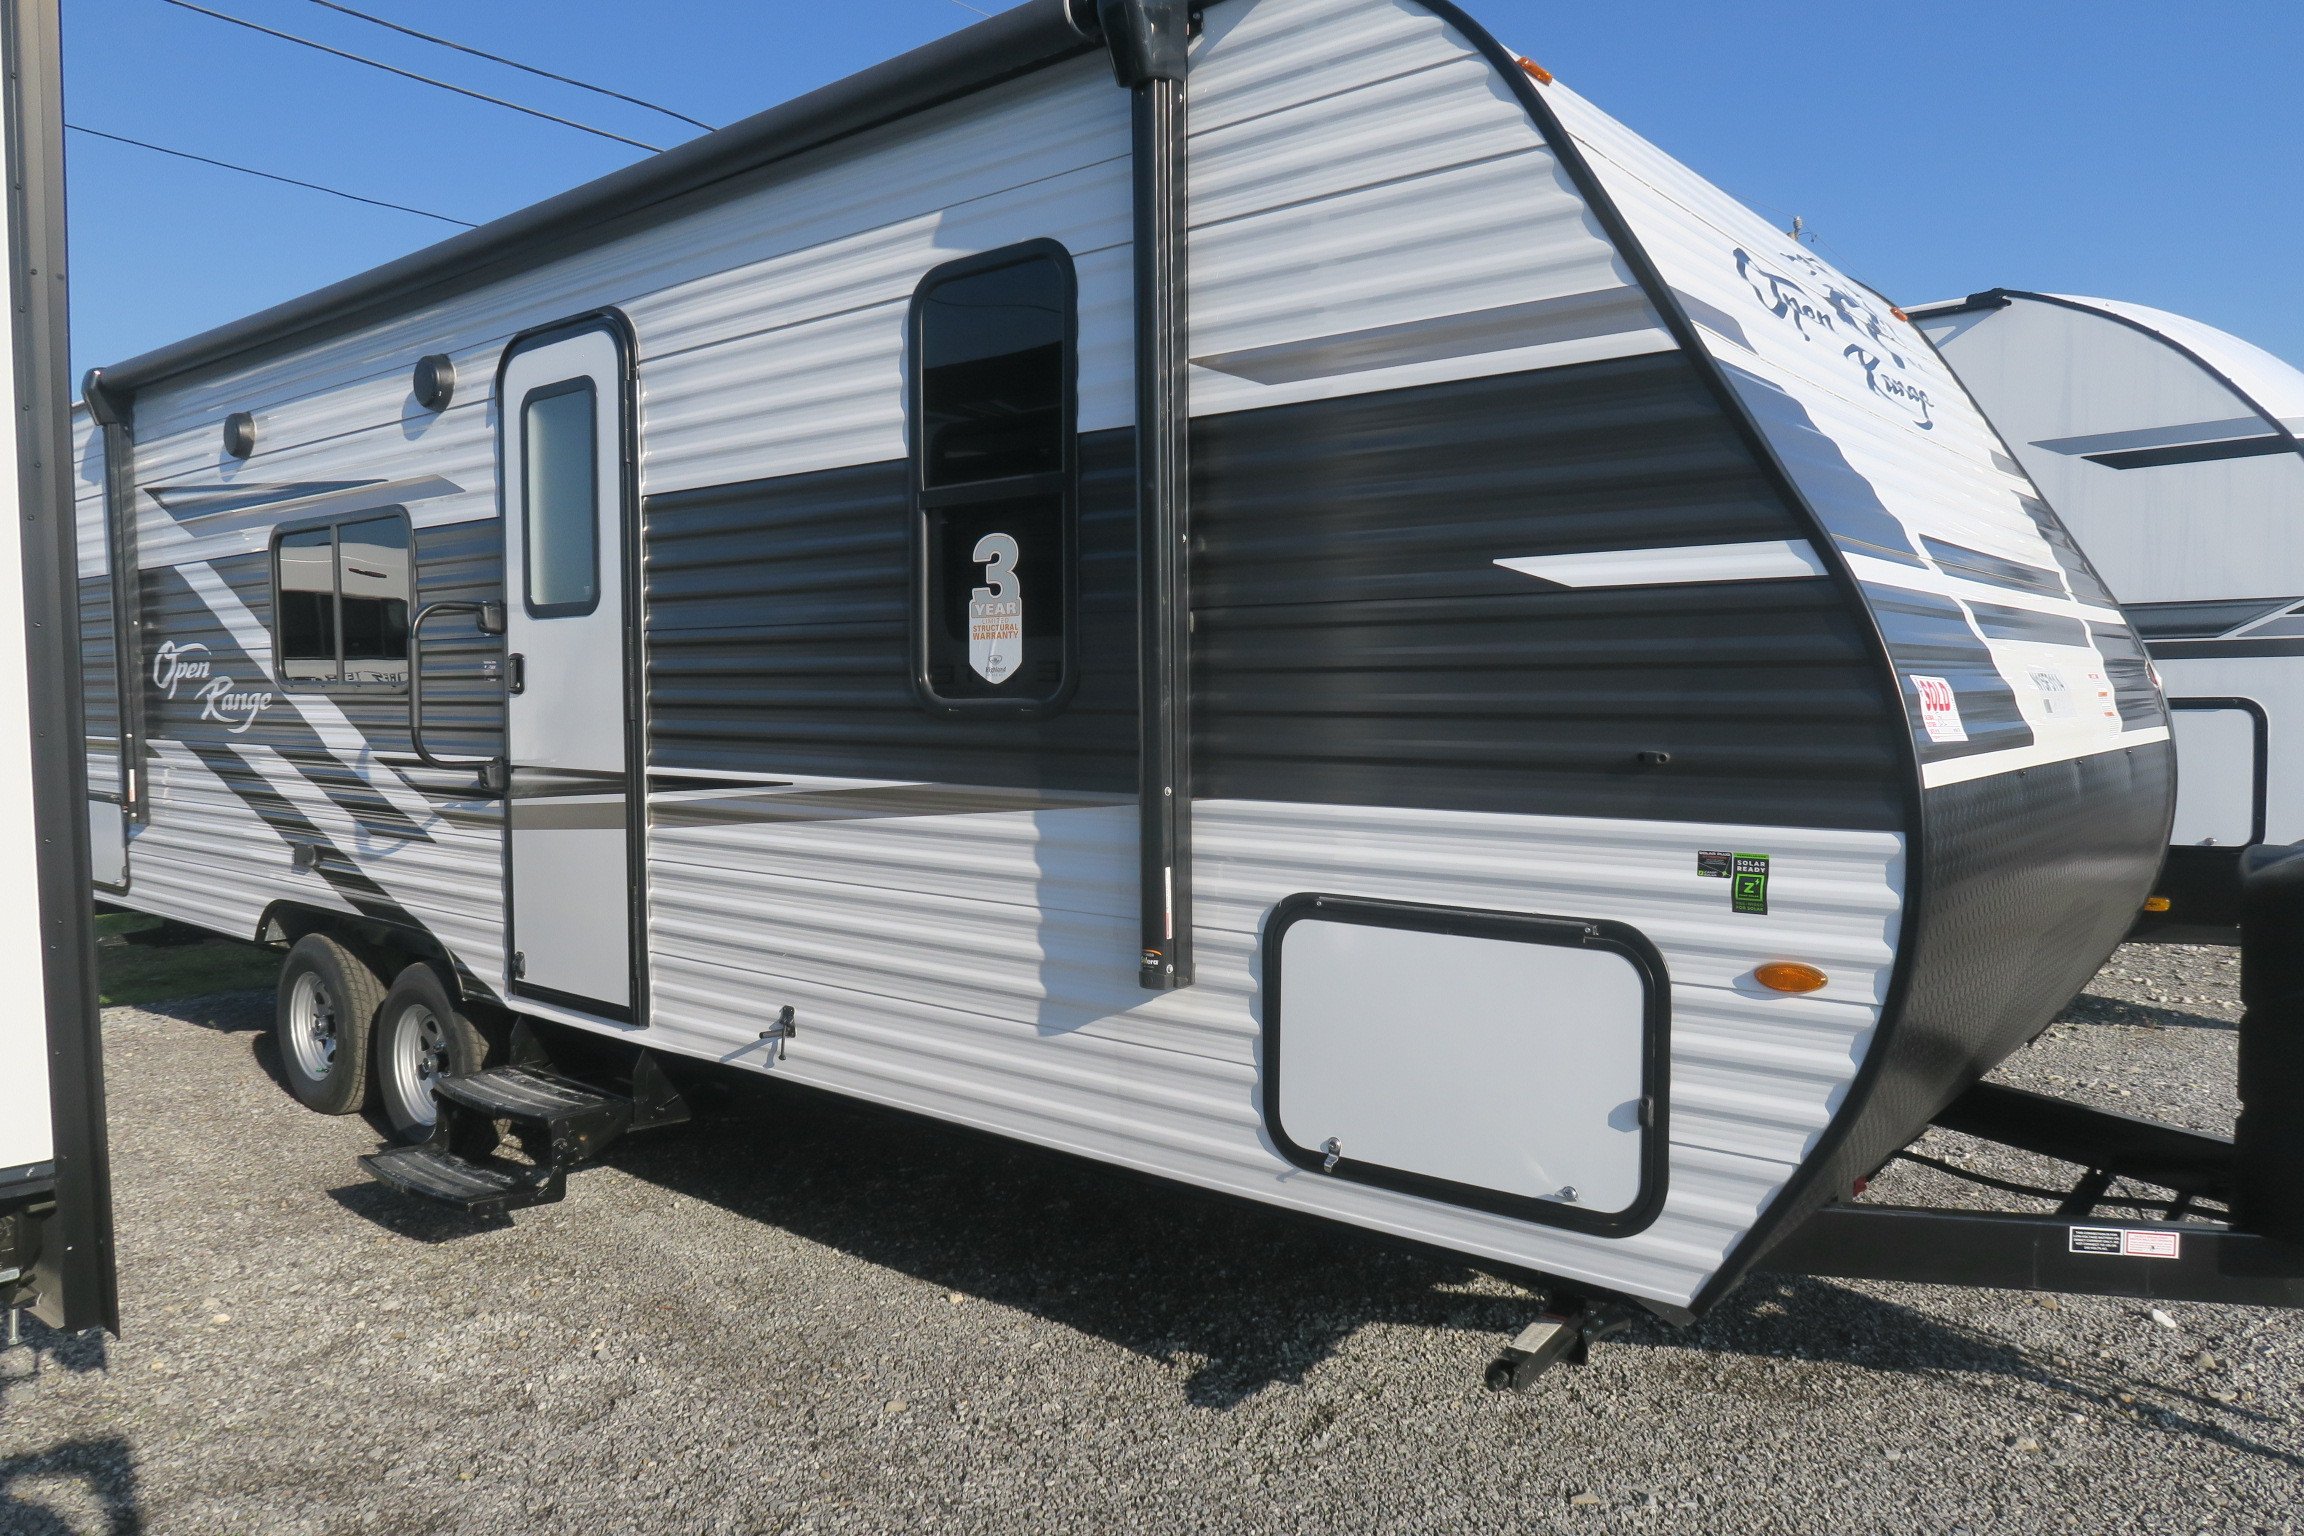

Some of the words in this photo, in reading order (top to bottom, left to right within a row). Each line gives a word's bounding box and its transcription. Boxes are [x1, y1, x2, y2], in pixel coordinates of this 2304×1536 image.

[972, 532, 1021, 600] 3
[974, 602, 1018, 616] YEAR
[972, 623, 1019, 632] STRUCTURAL
[972, 630, 1019, 640] WARRANTY
[153, 640, 212, 700] Open
[1919, 680, 1951, 711] SOLD
[194, 675, 273, 734] Range
[1736, 860, 1766, 868] SOLAR
[1736, 865, 1766, 873] READY
